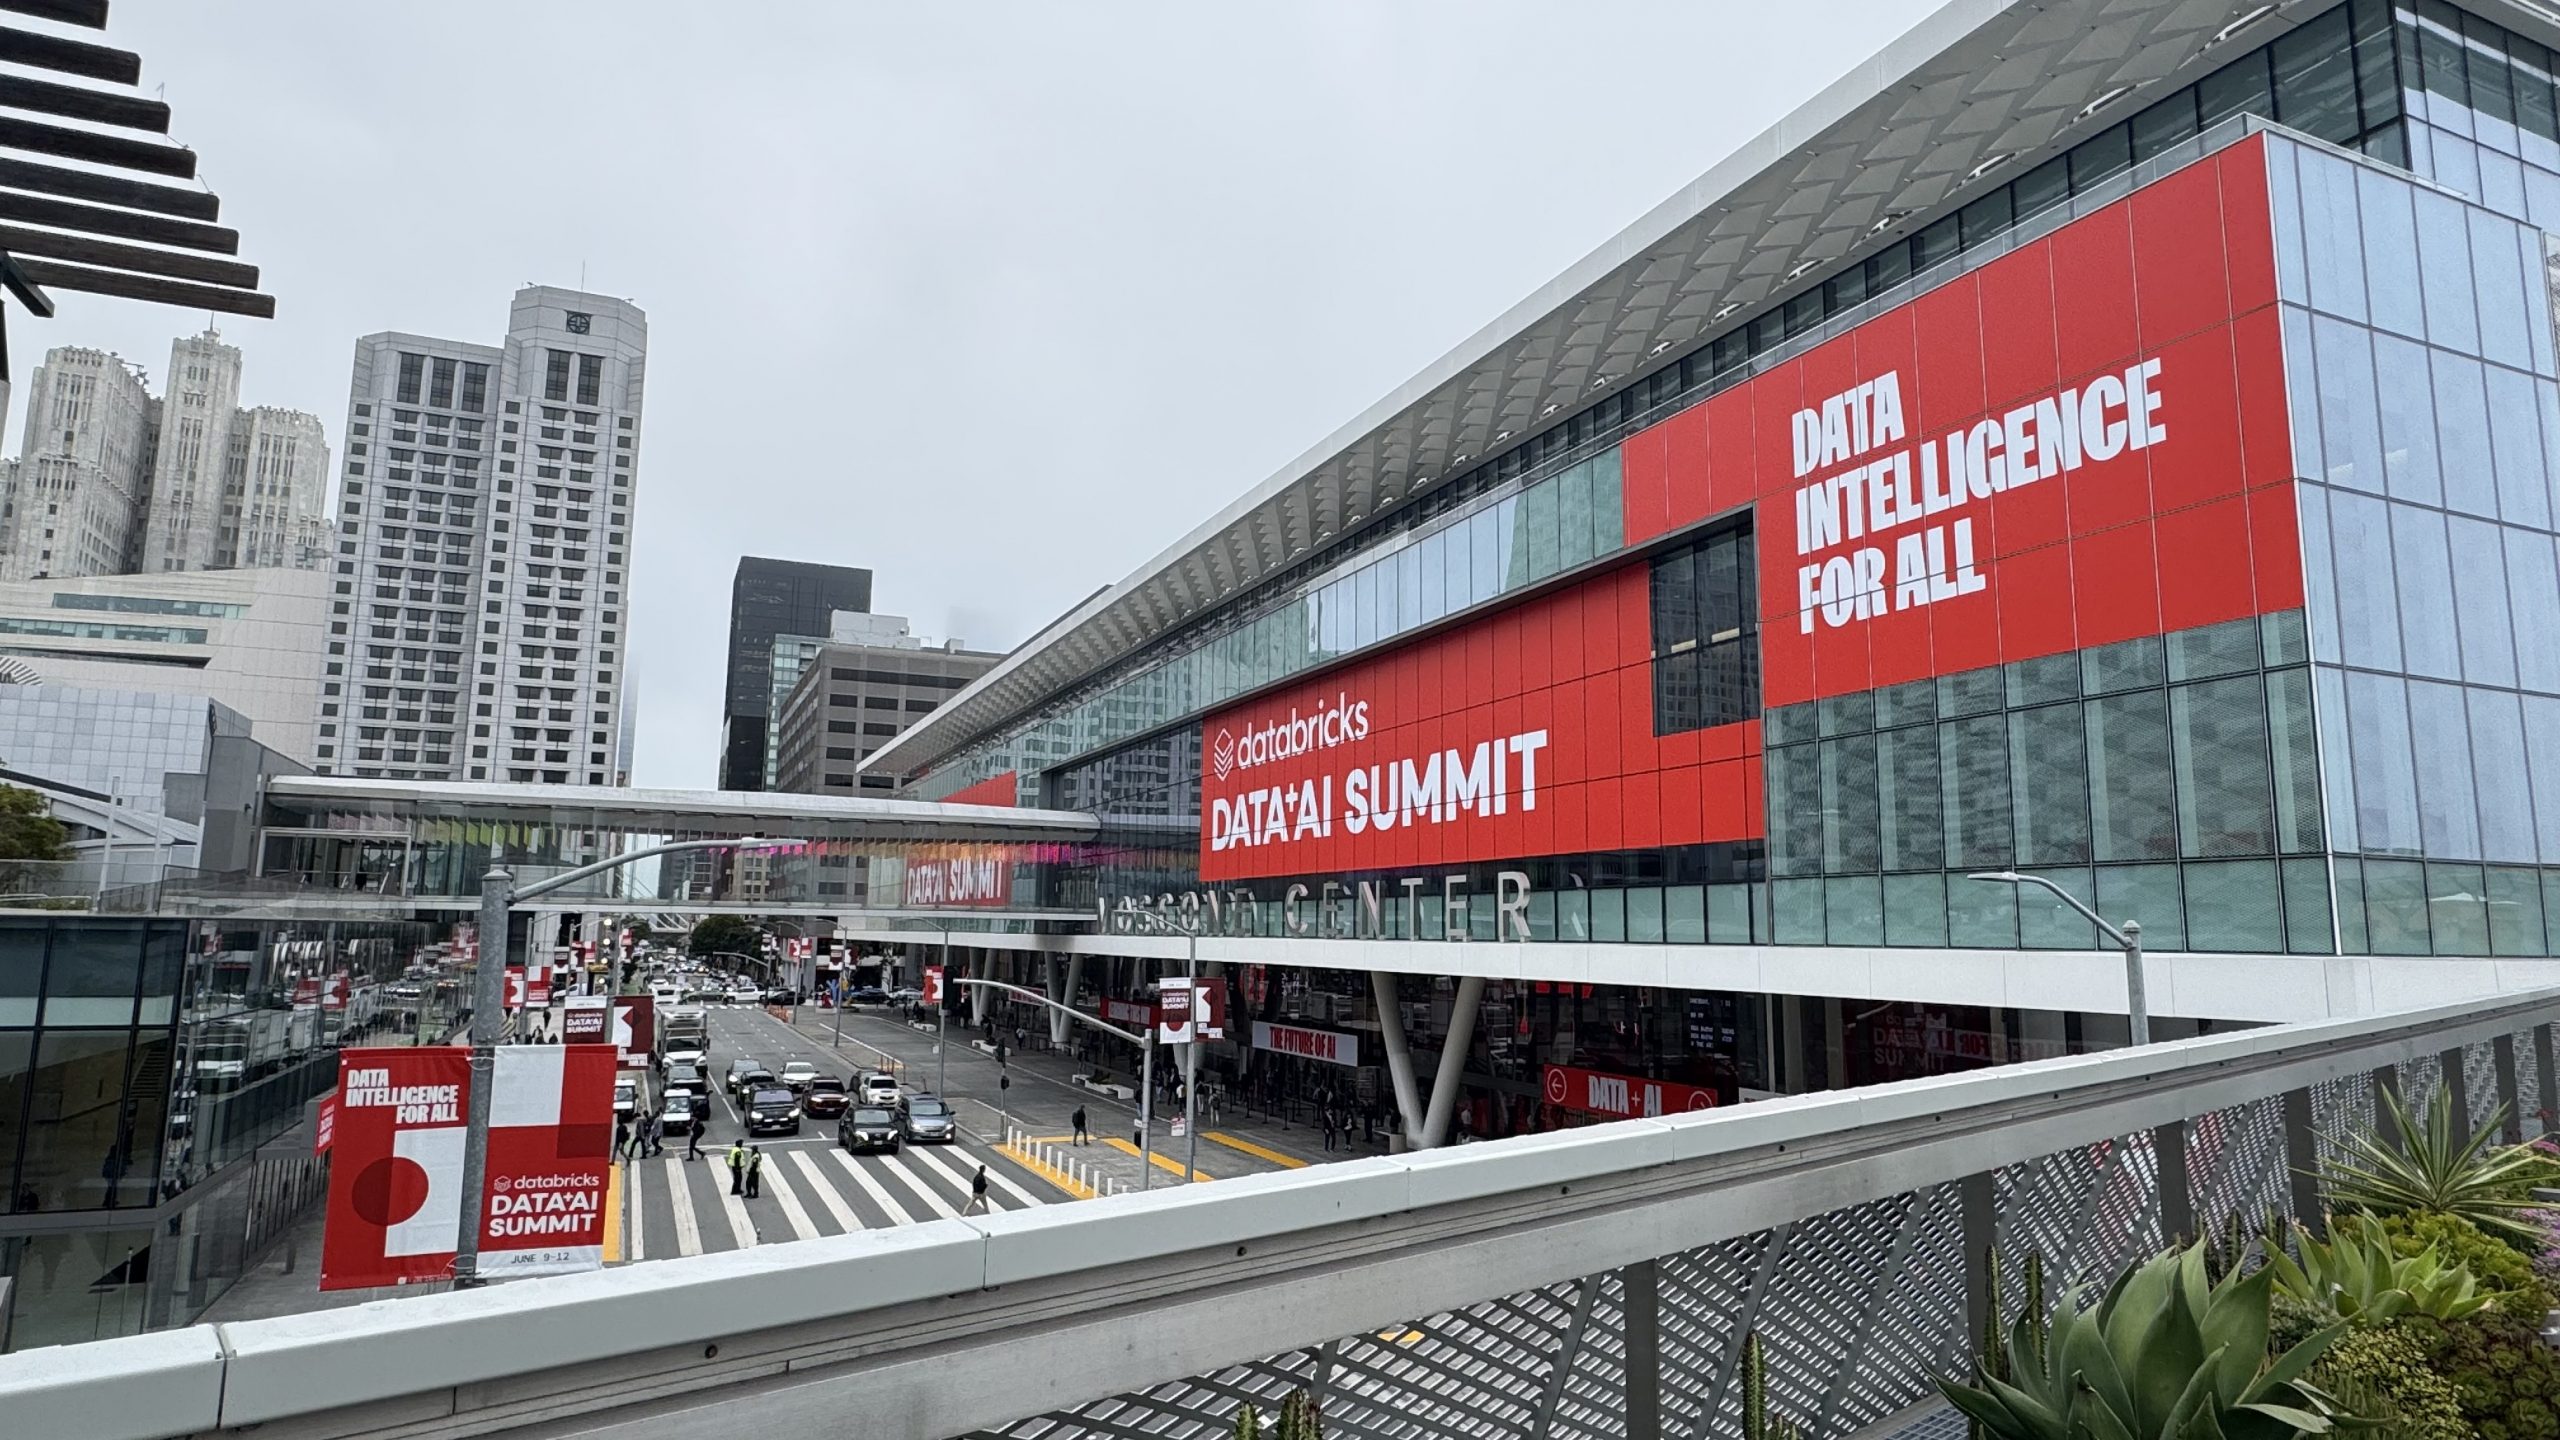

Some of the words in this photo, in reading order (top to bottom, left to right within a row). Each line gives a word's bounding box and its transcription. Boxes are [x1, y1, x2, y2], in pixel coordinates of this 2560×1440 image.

[1791, 370, 1905, 478] DATA
[1795, 357, 2167, 555] INTELLIGENCE
[1798, 547, 1887, 635] FOR
[1895, 517, 1986, 612] ALL
[1237, 691, 1369, 770] databricks
[1345, 728, 1548, 834] SUMMIT
[949, 854, 1002, 901] SUMMIT
[1285, 871, 1532, 943] CENTER
[1269, 1026, 1283, 1050] THE
[1284, 1028, 1314, 1056] FUTURE
[1315, 1033, 1326, 1058] OF
[1327, 1035, 1336, 1060] AI
[345, 1084, 459, 1108] INTELLIGENCE
[348, 1068, 389, 1088] DATA
[1588, 1075, 1629, 1114] DATA
[1644, 1084, 1662, 1117] AI
[396, 1106, 430, 1124] FOR
[430, 1103, 459, 1122] ALL
[514, 1172, 600, 1189] databricks
[488, 1213, 597, 1237] SUMMIT
[510, 1252, 537, 1265] JUNE
[543, 1251, 570, 1262] 9-12
